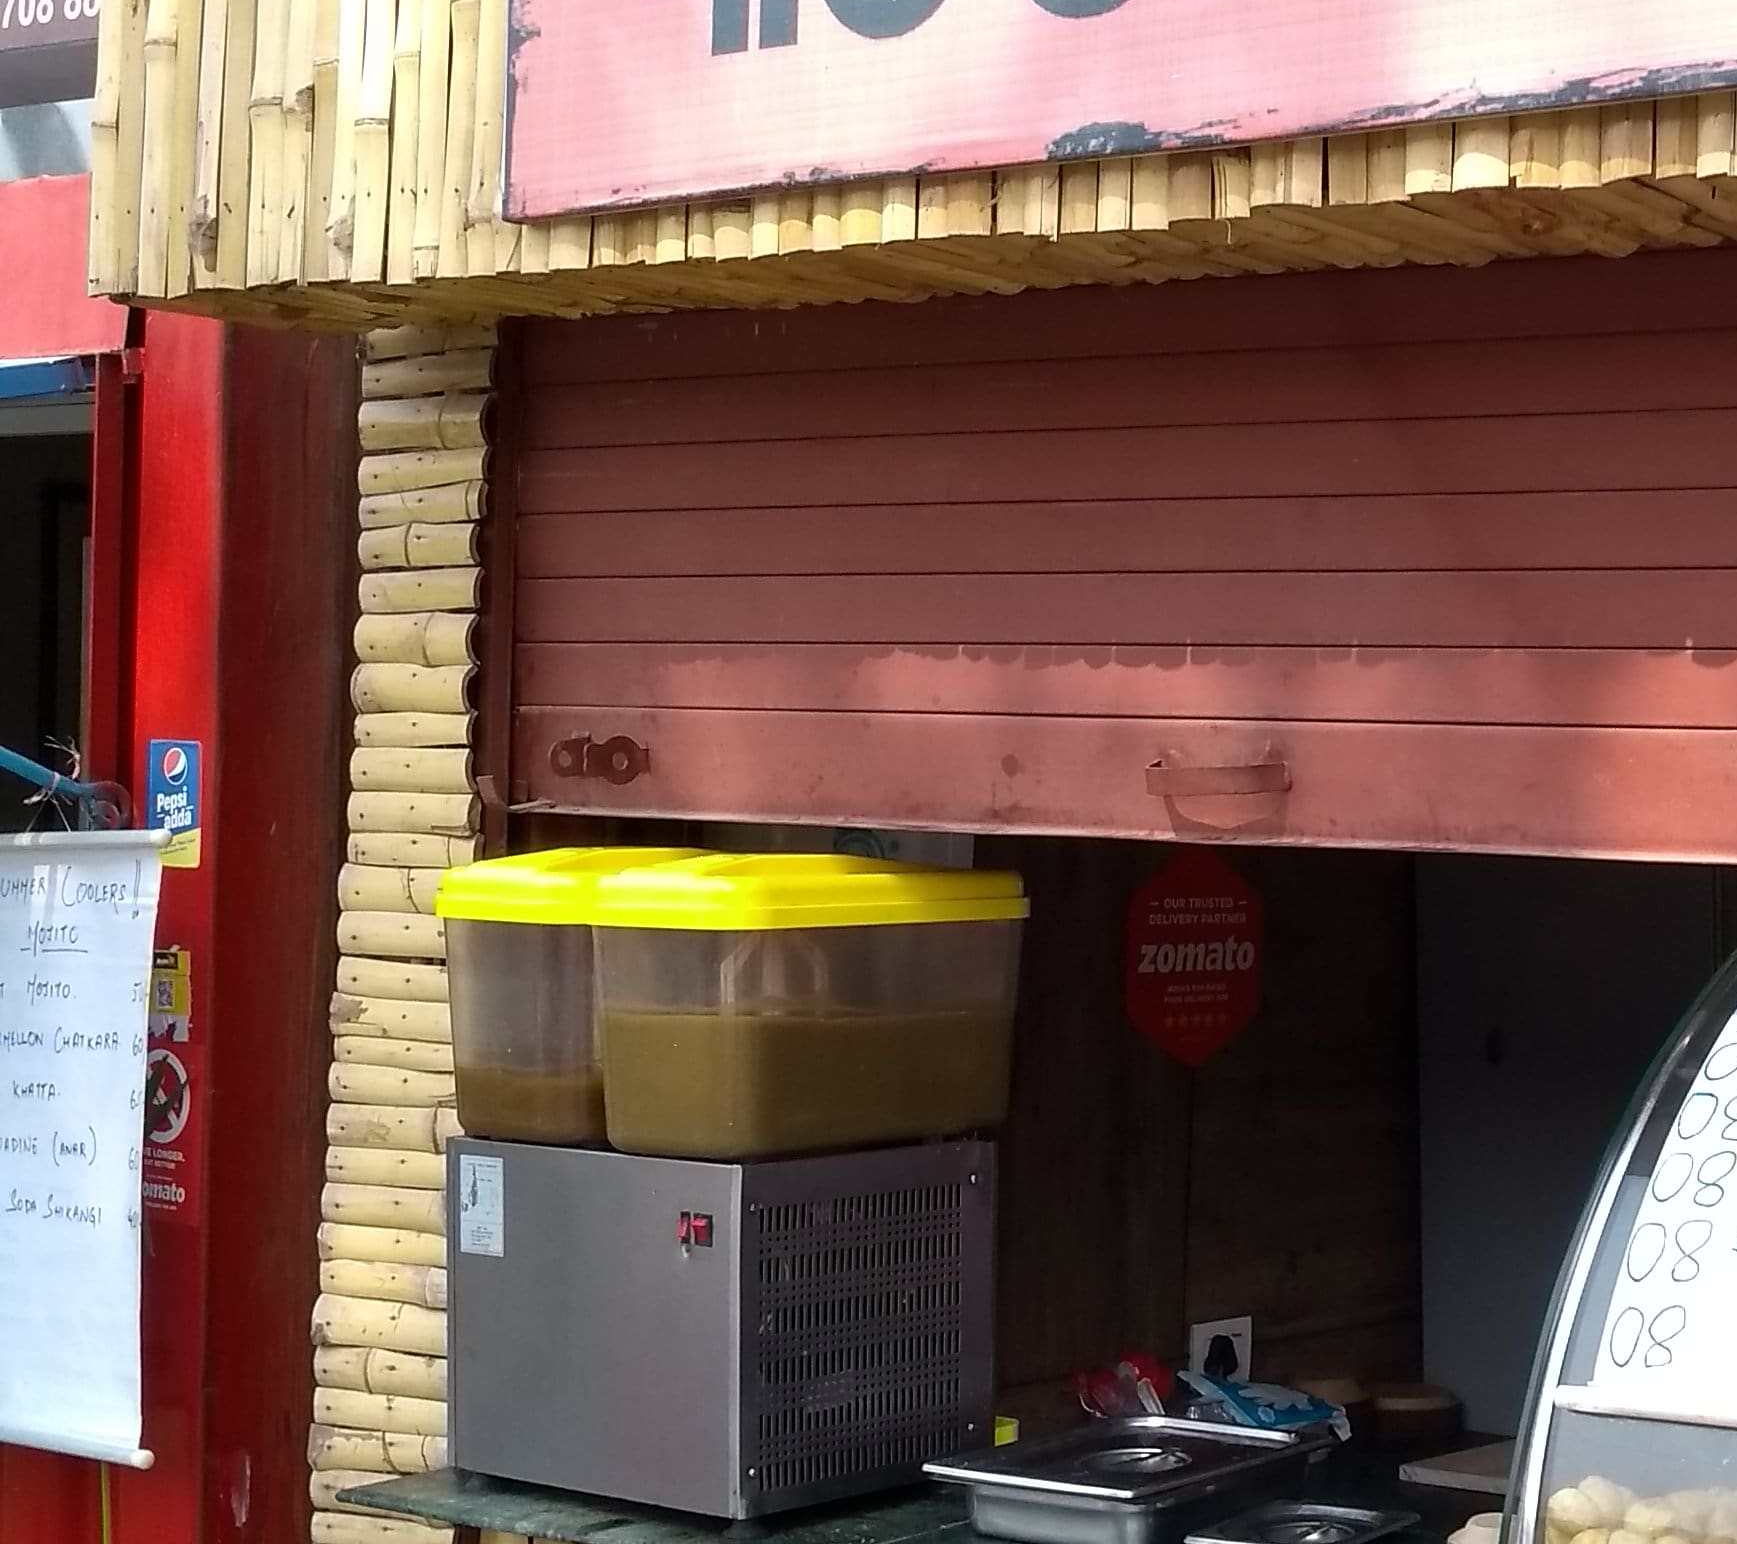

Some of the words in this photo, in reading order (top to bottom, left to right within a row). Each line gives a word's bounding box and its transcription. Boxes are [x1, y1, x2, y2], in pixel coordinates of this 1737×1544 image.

[157, 785, 187, 814] Pepsi
[164, 808, 192, 829] adda
[1164, 898, 1185, 909] OUR
[1188, 897, 1233, 909] TRUSTED
[1149, 914, 1198, 925] DELIVERY
[1201, 913, 1247, 924] PARTNER
[27, 920, 79, 956] MOJITO
[1138, 935, 1255, 973] zomato
[0, 1030, 43, 1053] MELLON
[1653, 1150, 1737, 1207] 80
[5, 1188, 37, 1213] SODA
[1627, 1219, 1712, 1282] 80
[1610, 1305, 1686, 1369] 80
